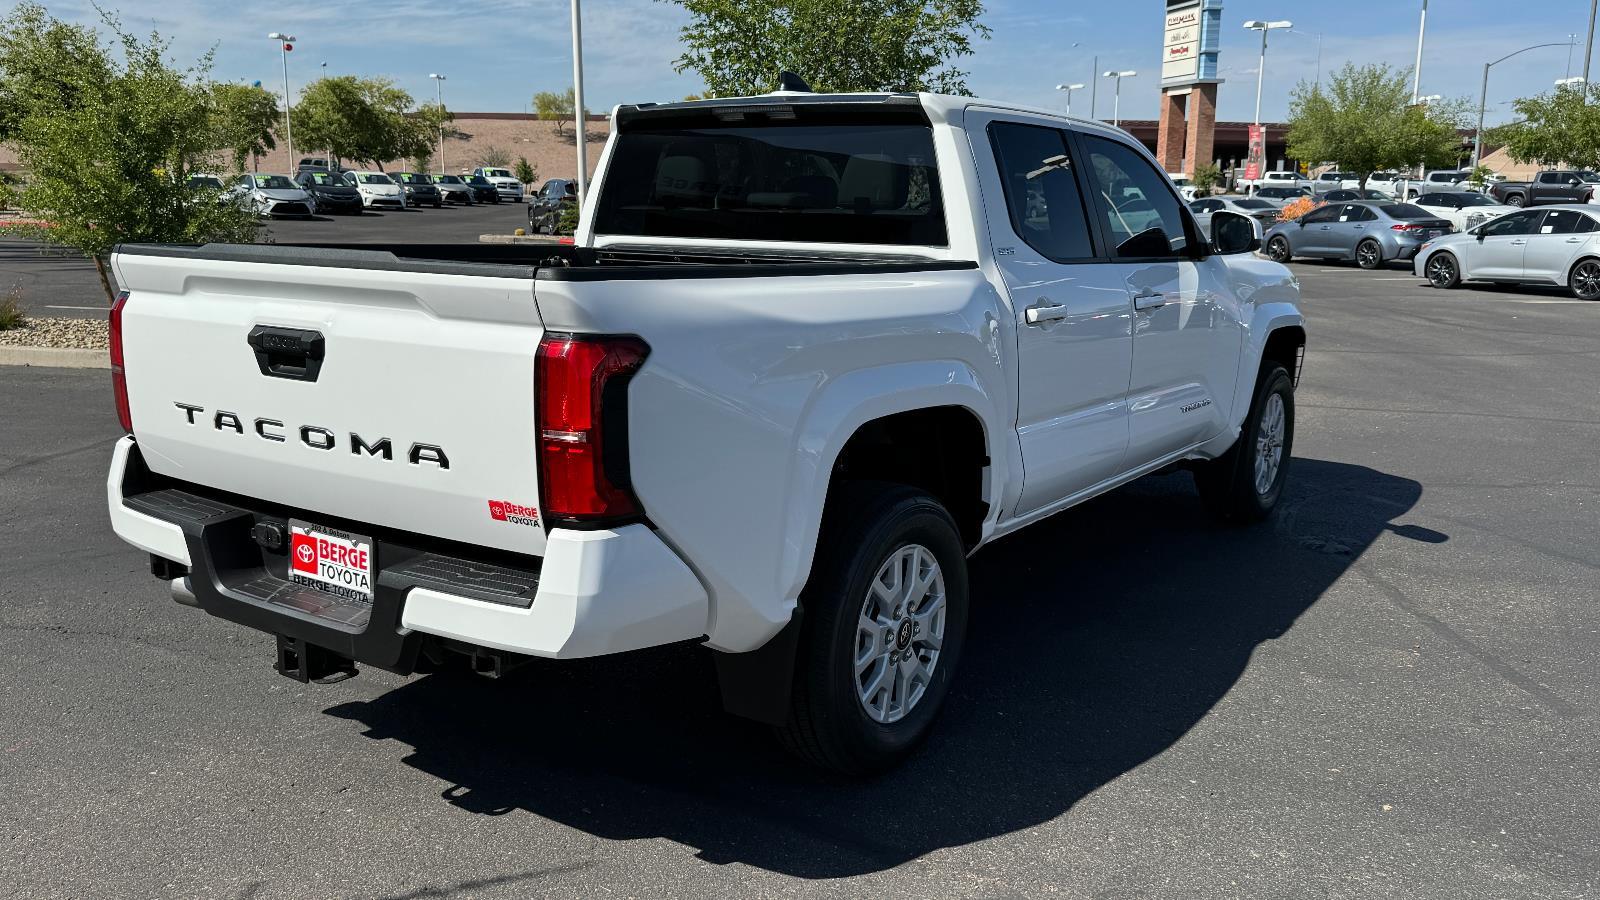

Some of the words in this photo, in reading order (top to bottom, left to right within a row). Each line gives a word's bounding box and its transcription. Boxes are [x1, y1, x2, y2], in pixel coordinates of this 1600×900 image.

[173, 401, 450, 470] TACOMA
[504, 501, 538, 518] BERGE
[507, 515, 541, 528] TOYOTA
[319, 539, 368, 570] BERGE
[293, 574, 330, 592] BERGE
[332, 585, 369, 603] TOYOTA
[320, 563, 369, 589] TOYOTA
